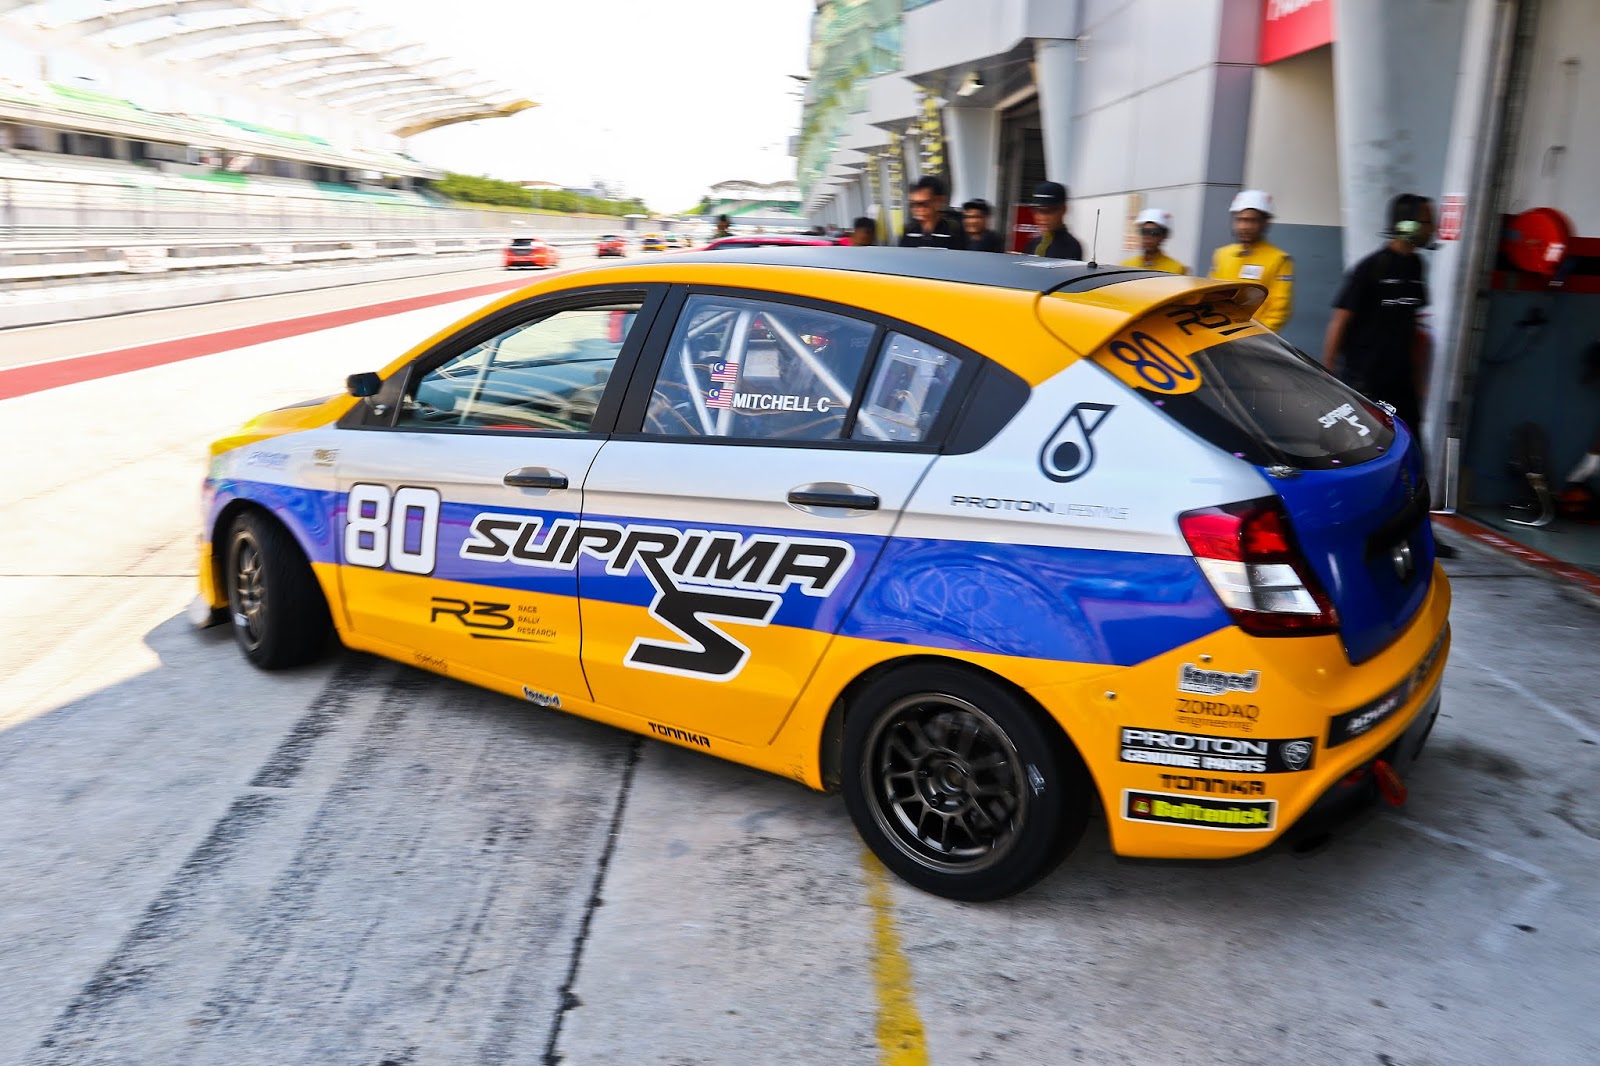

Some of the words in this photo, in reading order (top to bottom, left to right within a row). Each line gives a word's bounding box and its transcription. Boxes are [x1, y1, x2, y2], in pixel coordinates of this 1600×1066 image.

[1109, 330, 1195, 391] 80
[732, 392, 813, 412] MITCHELL
[816, 396, 831, 413] C
[344, 482, 441, 577] 80
[460, 513, 855, 597] SUPRIMA
[430, 596, 515, 631] R3
[517, 605, 538, 614] RACE
[517, 616, 541, 625] RALLY
[517, 627, 557, 638] RESEARCH
[624, 591, 782, 682] S
[1176, 698, 1260, 722] ZORDAQ
[1122, 729, 1268, 755] PROTON
[1121, 749, 1200, 768] GENUINE
[1202, 756, 1267, 773] PARTS
